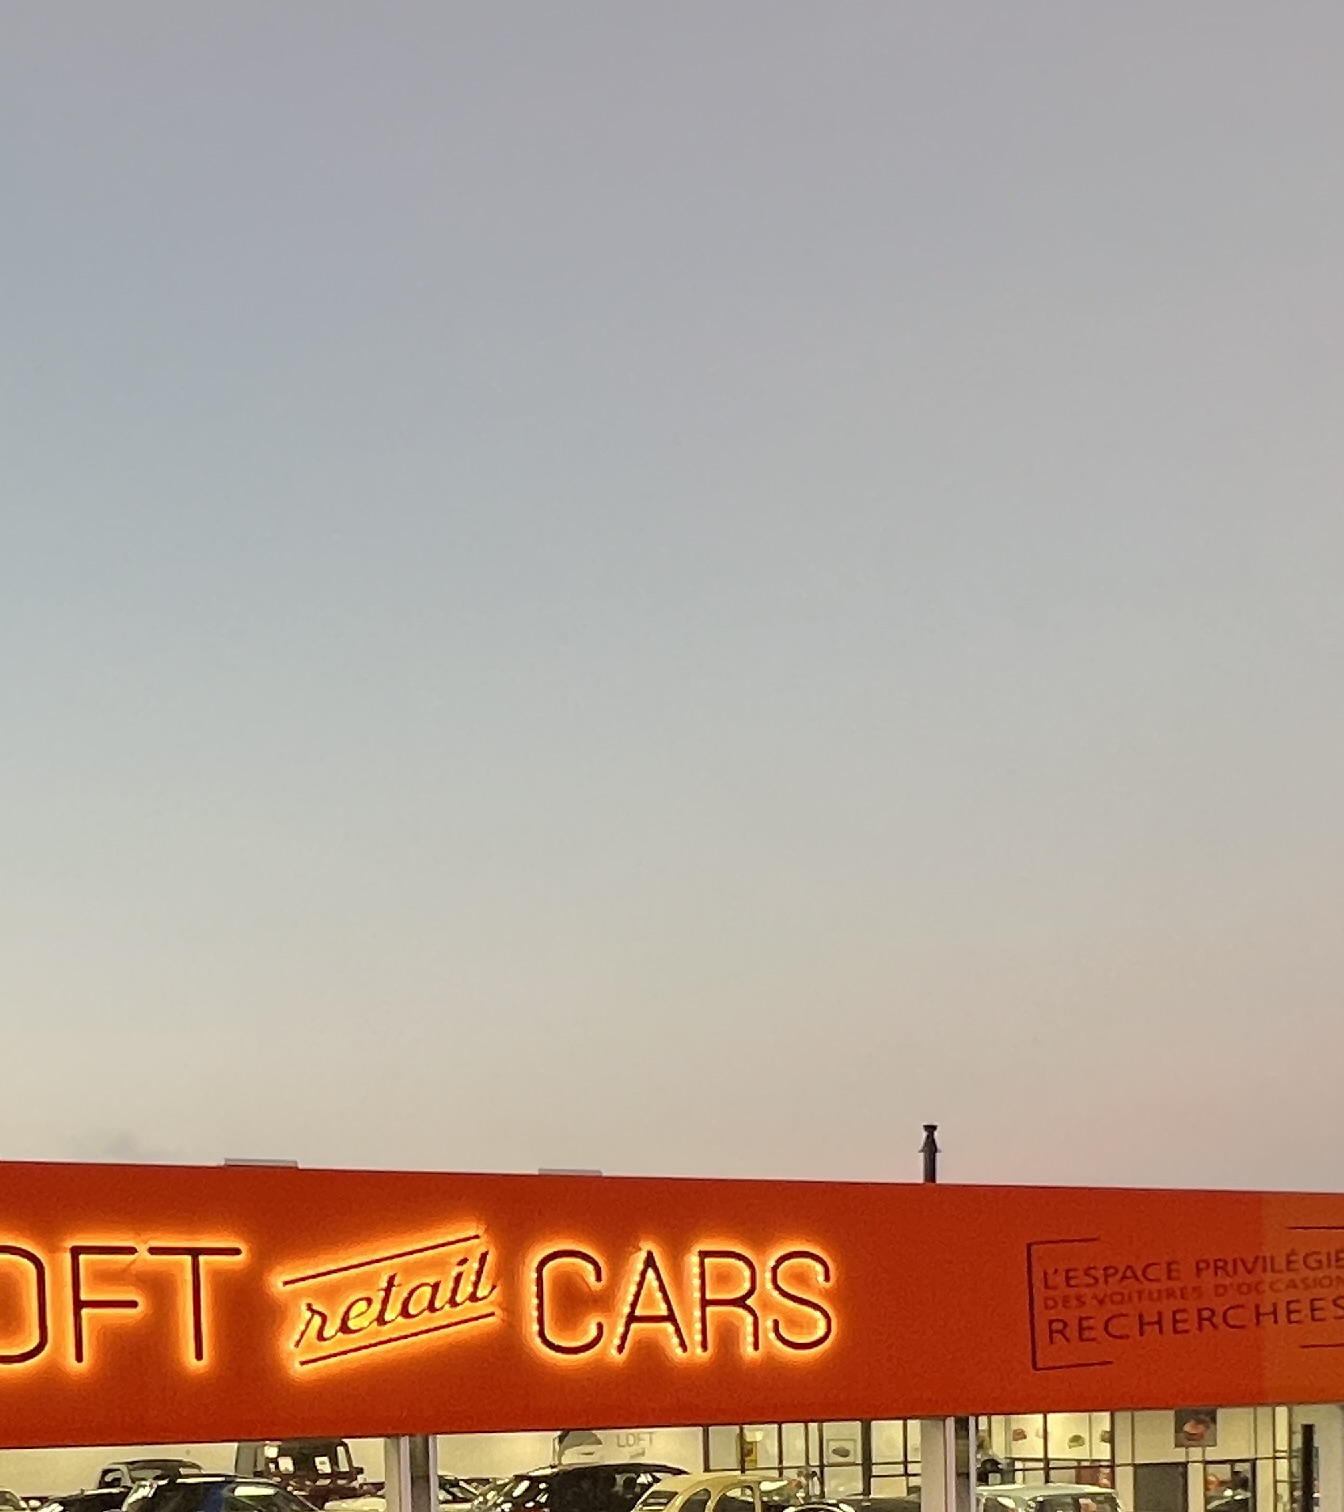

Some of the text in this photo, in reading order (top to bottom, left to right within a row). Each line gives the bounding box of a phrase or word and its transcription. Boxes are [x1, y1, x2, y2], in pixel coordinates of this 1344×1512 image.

[1042, 1260, 1181, 1290] L'ESPACE
[294, 1249, 498, 1349] retail
[535, 1248, 834, 1356] CARS
[1042, 1294, 1086, 1311] DES
[616, 1431, 654, 1448] LOFT
